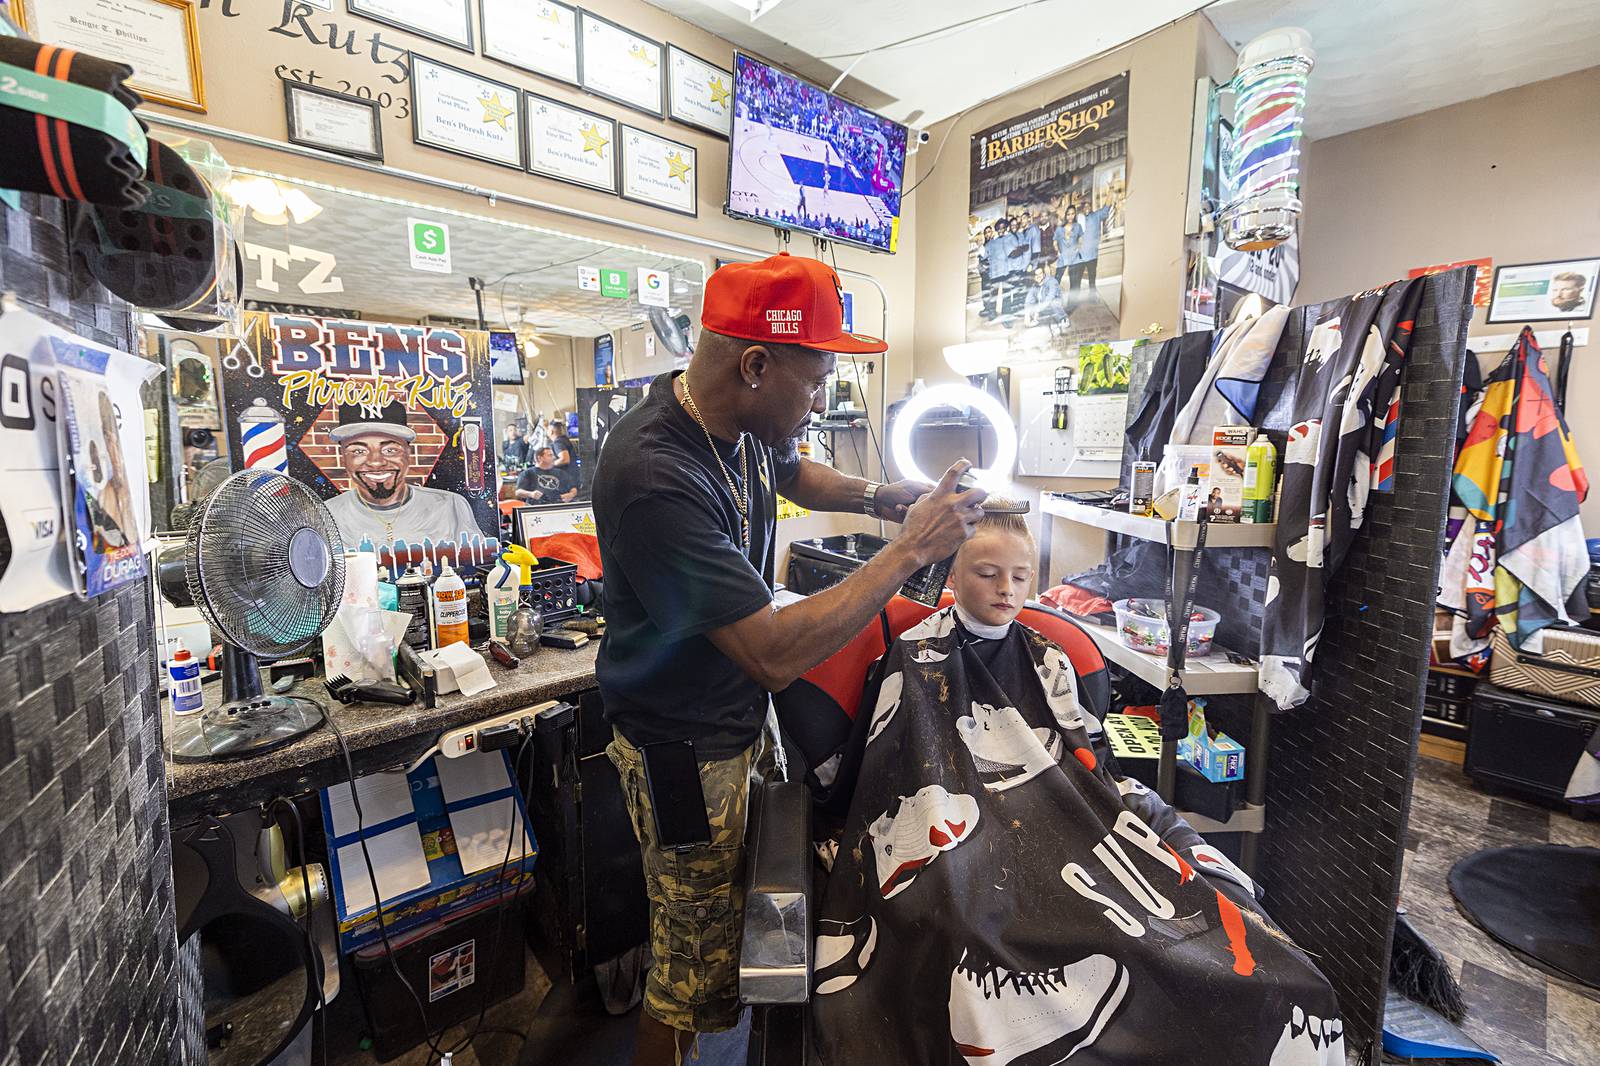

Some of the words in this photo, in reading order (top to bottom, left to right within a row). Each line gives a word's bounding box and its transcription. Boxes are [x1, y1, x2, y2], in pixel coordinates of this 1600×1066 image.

[115, 28, 148, 43] Phillips
[336, 80, 410, 119] 2003
[453, 102, 470, 112] Place
[436, 115, 457, 128] Ben's
[458, 121, 485, 137] Phresh
[486, 130, 504, 142] Kutz
[766, 309, 802, 322] CHICAGO
[771, 322, 799, 334] BULLS
[277, 369, 395, 410] Phresh
[395, 373, 473, 417] Kutz
[32, 519, 54, 540] VISA
[103, 555, 142, 582] DURAG
[1114, 727, 1147, 754] OPEN
